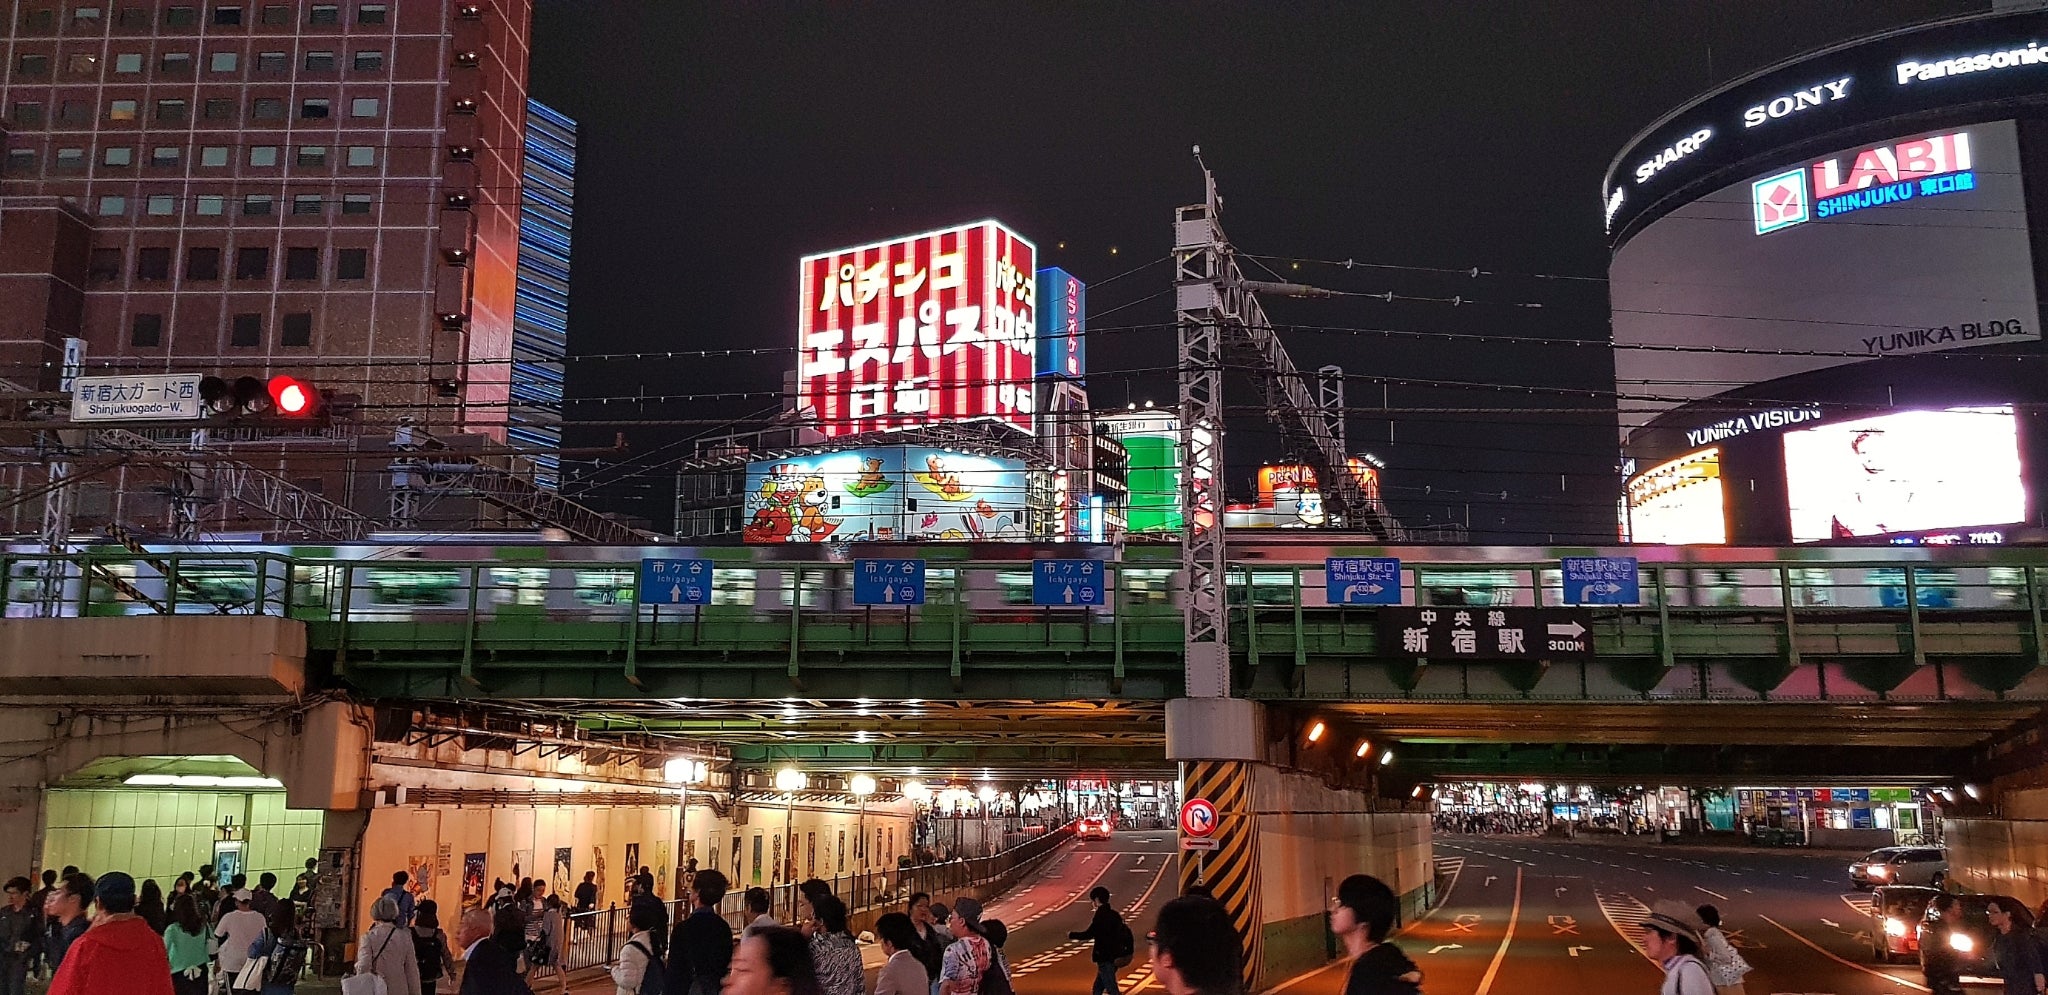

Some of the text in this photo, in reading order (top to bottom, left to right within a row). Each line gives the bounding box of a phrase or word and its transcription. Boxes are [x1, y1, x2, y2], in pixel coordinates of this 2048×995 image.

[1896, 42, 2048, 85] Panasonic
[1744, 78, 1850, 128] SONY
[1636, 128, 1711, 184] SHARP
[1812, 132, 1972, 199] LABI
[1817, 173, 1974, 218] SHINJUKU 東口館
[820, 253, 964, 311] パチンコ
[803, 300, 986, 377] エスパス
[1862, 318, 2027, 354] YUNIKA BLDG.
[80, 381, 195, 402] 新宿大ガード西
[1686, 400, 1821, 447] YUNIKA VISION
[657, 575, 696, 584] Ichigaya
[870, 575, 909, 584] Ichigaya
[1049, 575, 1088, 585] Ichigaya
[1331, 560, 1395, 573] 新宿駅東口
[1334, 572, 1366, 581] Shinjuku
[1421, 609, 1506, 627] 中央線
[1403, 627, 1526, 654] 新宿駅
[1548, 640, 1585, 652] 300M
